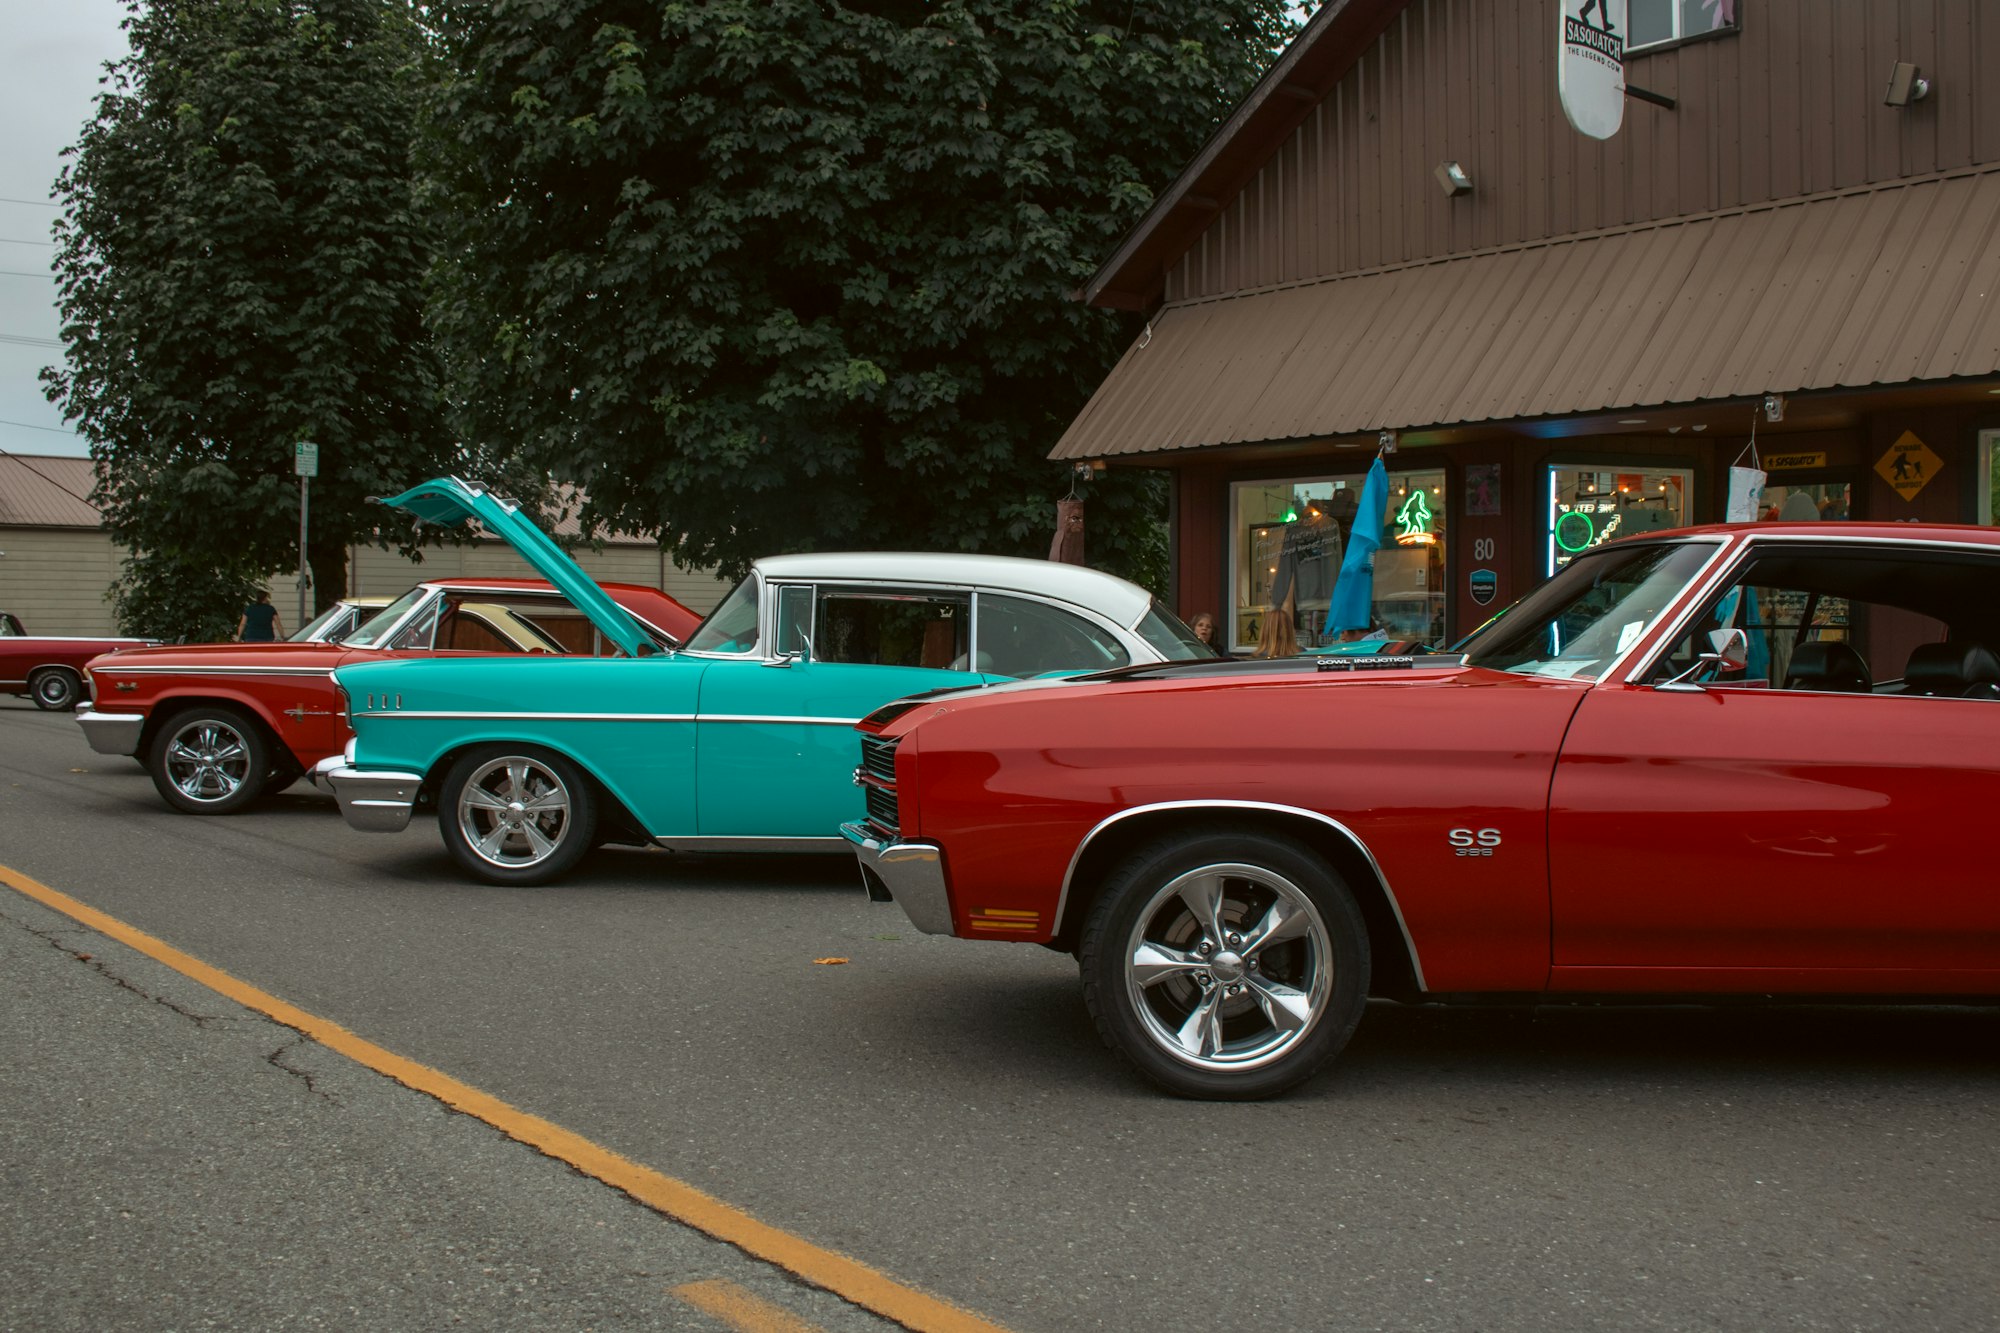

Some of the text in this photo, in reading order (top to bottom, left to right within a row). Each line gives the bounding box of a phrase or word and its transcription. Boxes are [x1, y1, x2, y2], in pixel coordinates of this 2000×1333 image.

[1567, 21, 1621, 61] SASQUATCH
[1567, 46, 1580, 55] THE
[1894, 444, 1922, 452] BEWARE
[1775, 455, 1817, 467] SASQUATCH
[1895, 481, 1922, 489] BIGFOOT
[1474, 537, 1495, 561] 80
[1353, 656, 1413, 664] INDUCTION
[1448, 828, 1502, 847] SS
